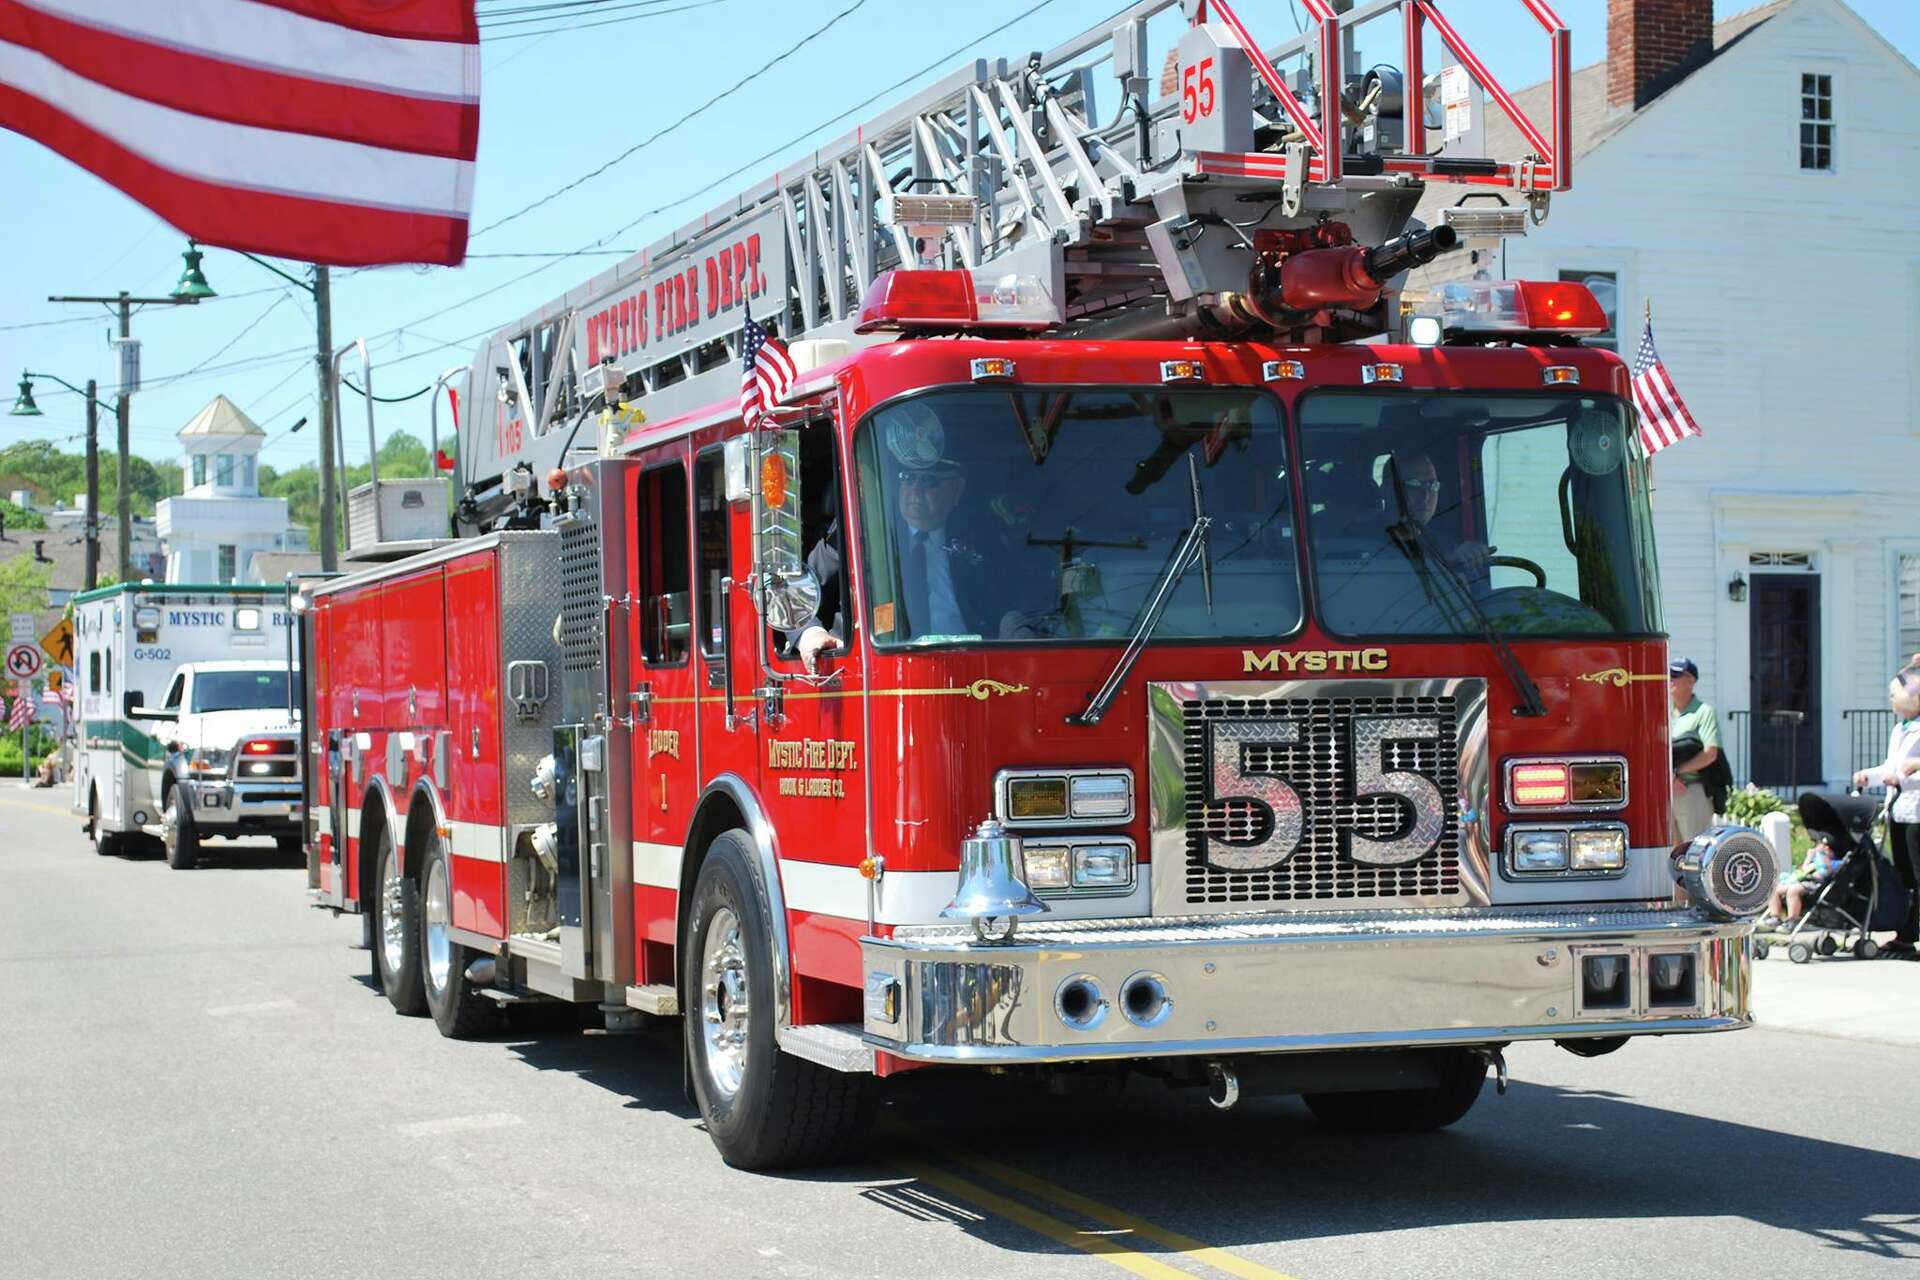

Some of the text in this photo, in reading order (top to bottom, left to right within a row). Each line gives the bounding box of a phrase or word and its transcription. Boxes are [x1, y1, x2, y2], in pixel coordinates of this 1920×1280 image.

[1183, 56, 1214, 124] 55
[586, 233, 767, 369] MYSTIC FIRE DEPT.
[169, 611, 225, 625] MYSTIC
[134, 649, 171, 660] G-502
[1243, 648, 1388, 673] MYSTIC
[648, 729, 679, 759] LADDER
[768, 737, 858, 770] MYSTIC FIRE DEPT.
[805, 777, 831, 798] LADDER
[1205, 715, 1448, 873] 55
